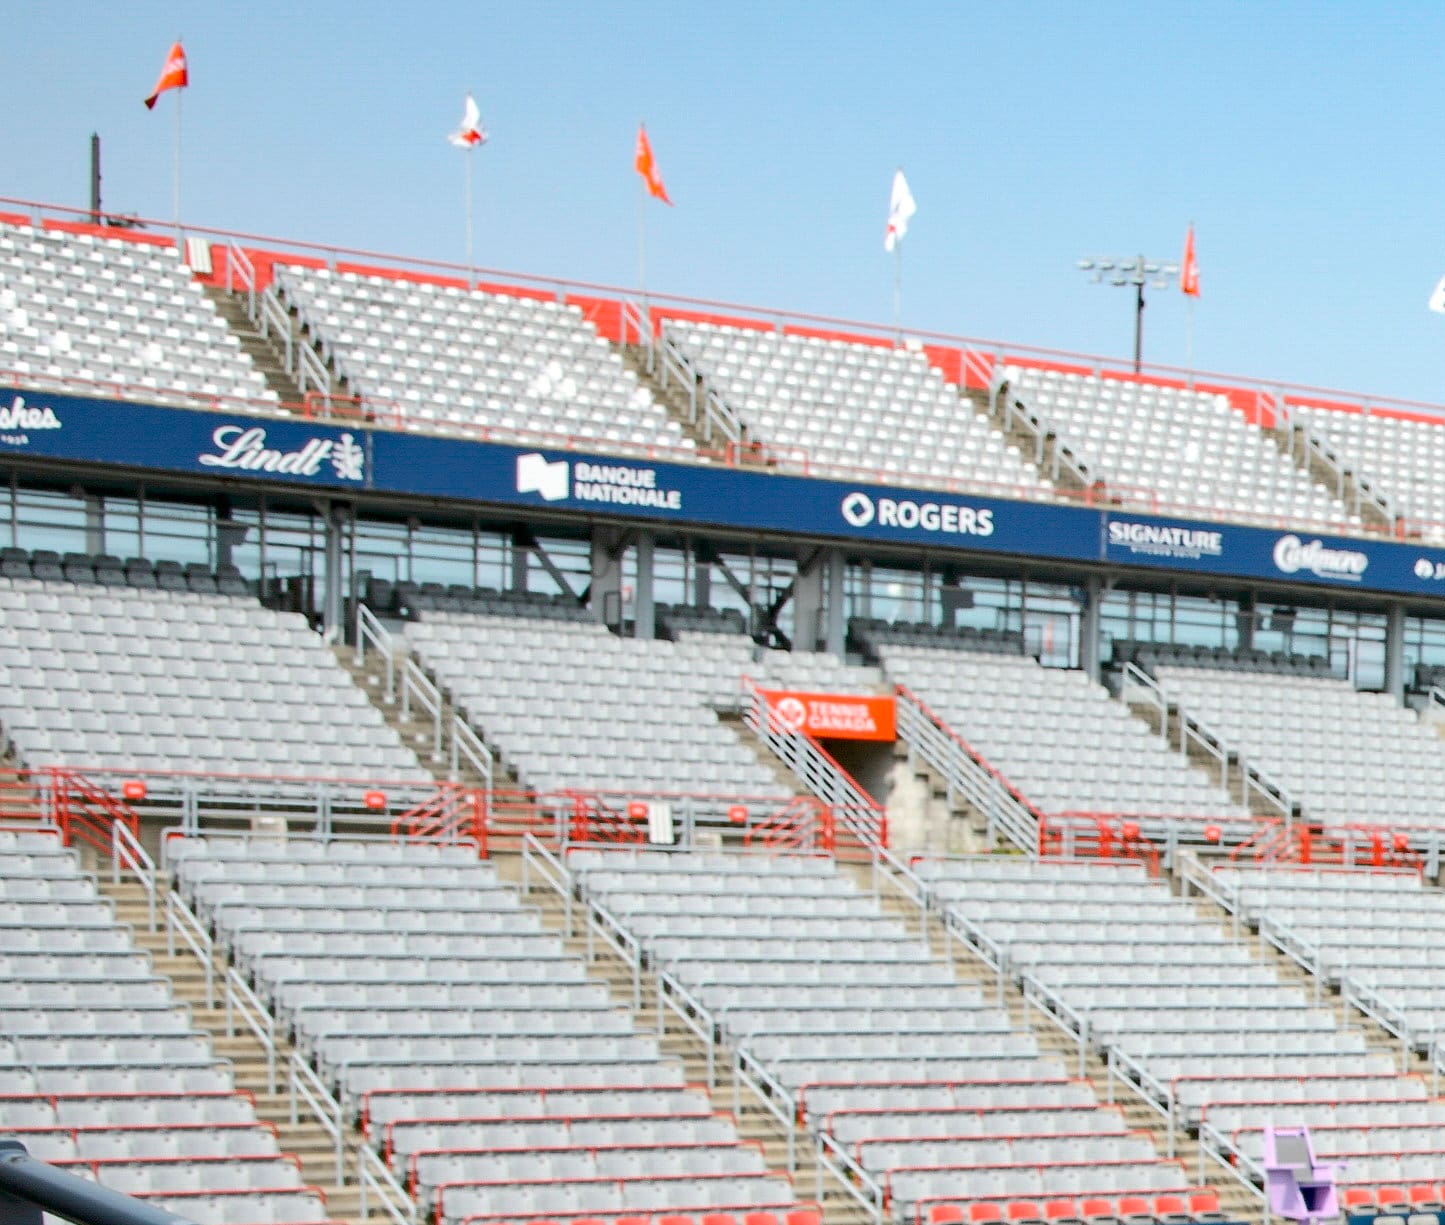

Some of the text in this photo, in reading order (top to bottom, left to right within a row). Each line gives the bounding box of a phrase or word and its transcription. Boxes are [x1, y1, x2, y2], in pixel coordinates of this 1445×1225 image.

[198, 425, 334, 476] Lindt
[574, 461, 656, 489] BANQUE
[574, 481, 682, 510] NATIONALE
[877, 498, 995, 537] ROGERS
[1108, 521, 1223, 551] SIGNATURE
[807, 700, 870, 718] TENNIS
[807, 715, 877, 732] CANADA
